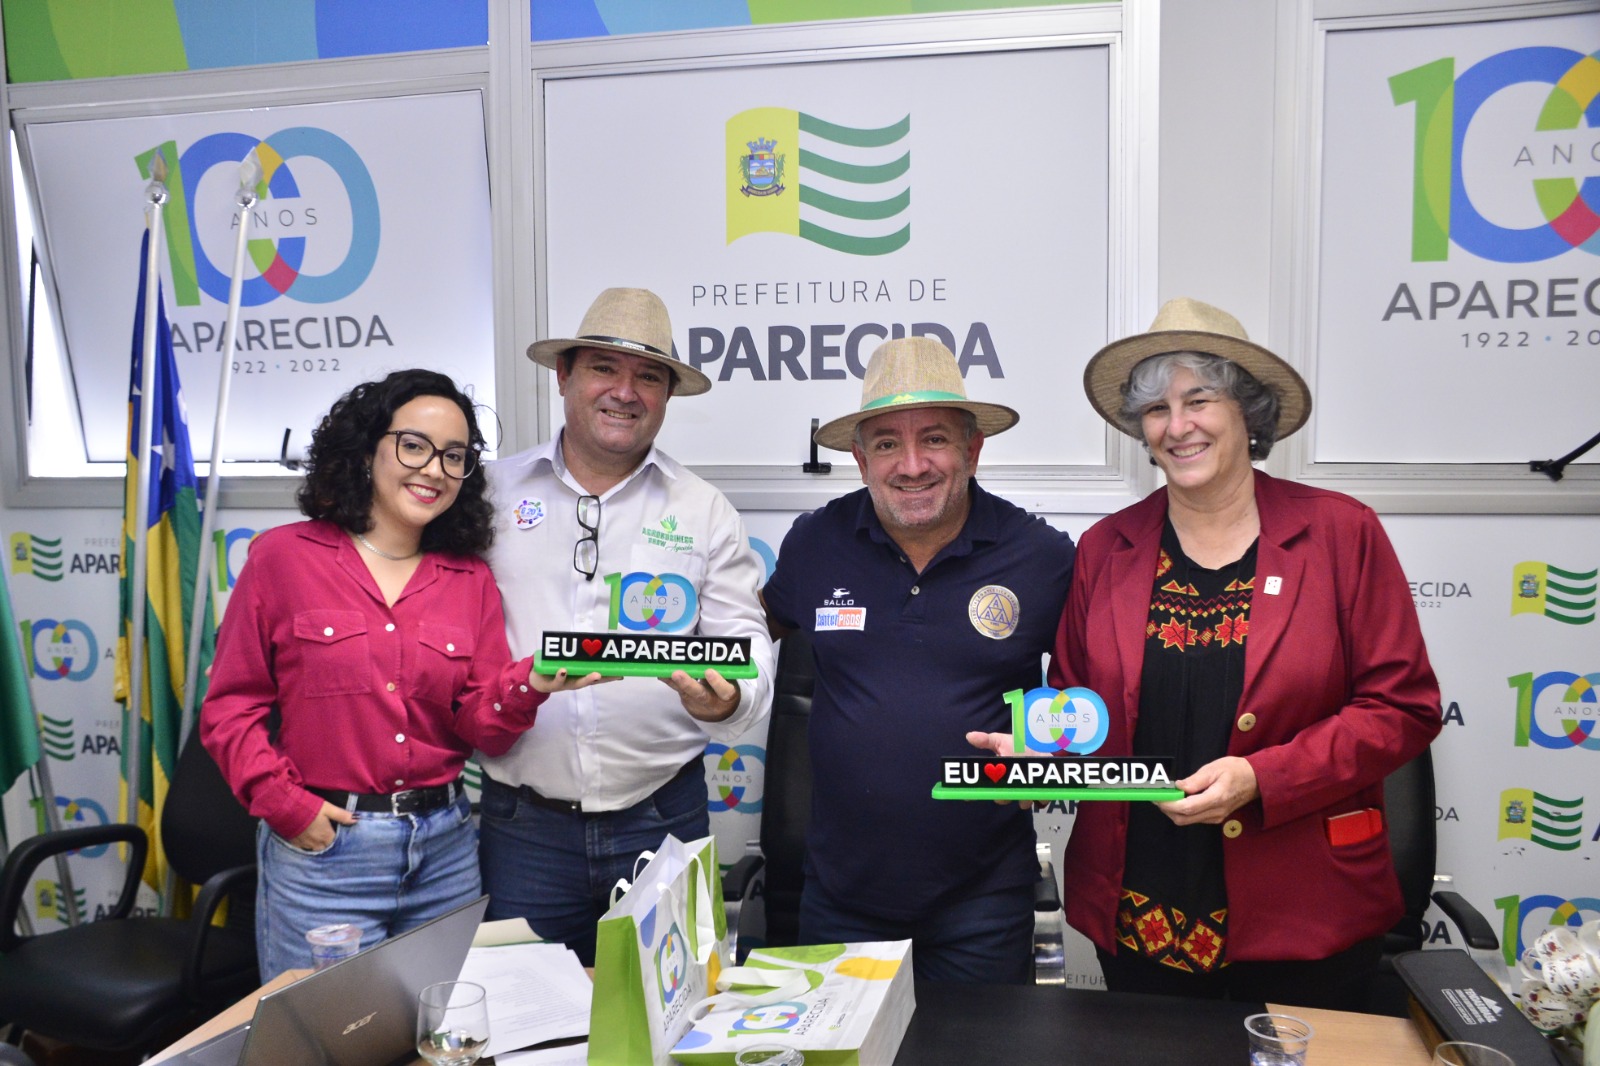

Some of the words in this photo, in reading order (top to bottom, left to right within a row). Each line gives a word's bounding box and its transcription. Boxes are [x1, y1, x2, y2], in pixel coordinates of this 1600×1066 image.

[230, 207, 318, 230] ANOS
[692, 280, 891, 306] PREFEITURA
[909, 278, 947, 301] DE
[671, 321, 1005, 382] PARECA
[1461, 332, 1530, 348] 1922
[232, 360, 267, 374] 922
[290, 358, 341, 373] 2022
[602, 571, 697, 632] 100
[630, 595, 679, 606] ANOS
[544, 637, 578, 657] EU
[601, 640, 746, 662] APARECIDA
[1003, 686, 1110, 755] 100
[1036, 713, 1091, 724] ANOS
[944, 762, 979, 783] EU
[1007, 762, 1171, 785] APARECIDA
